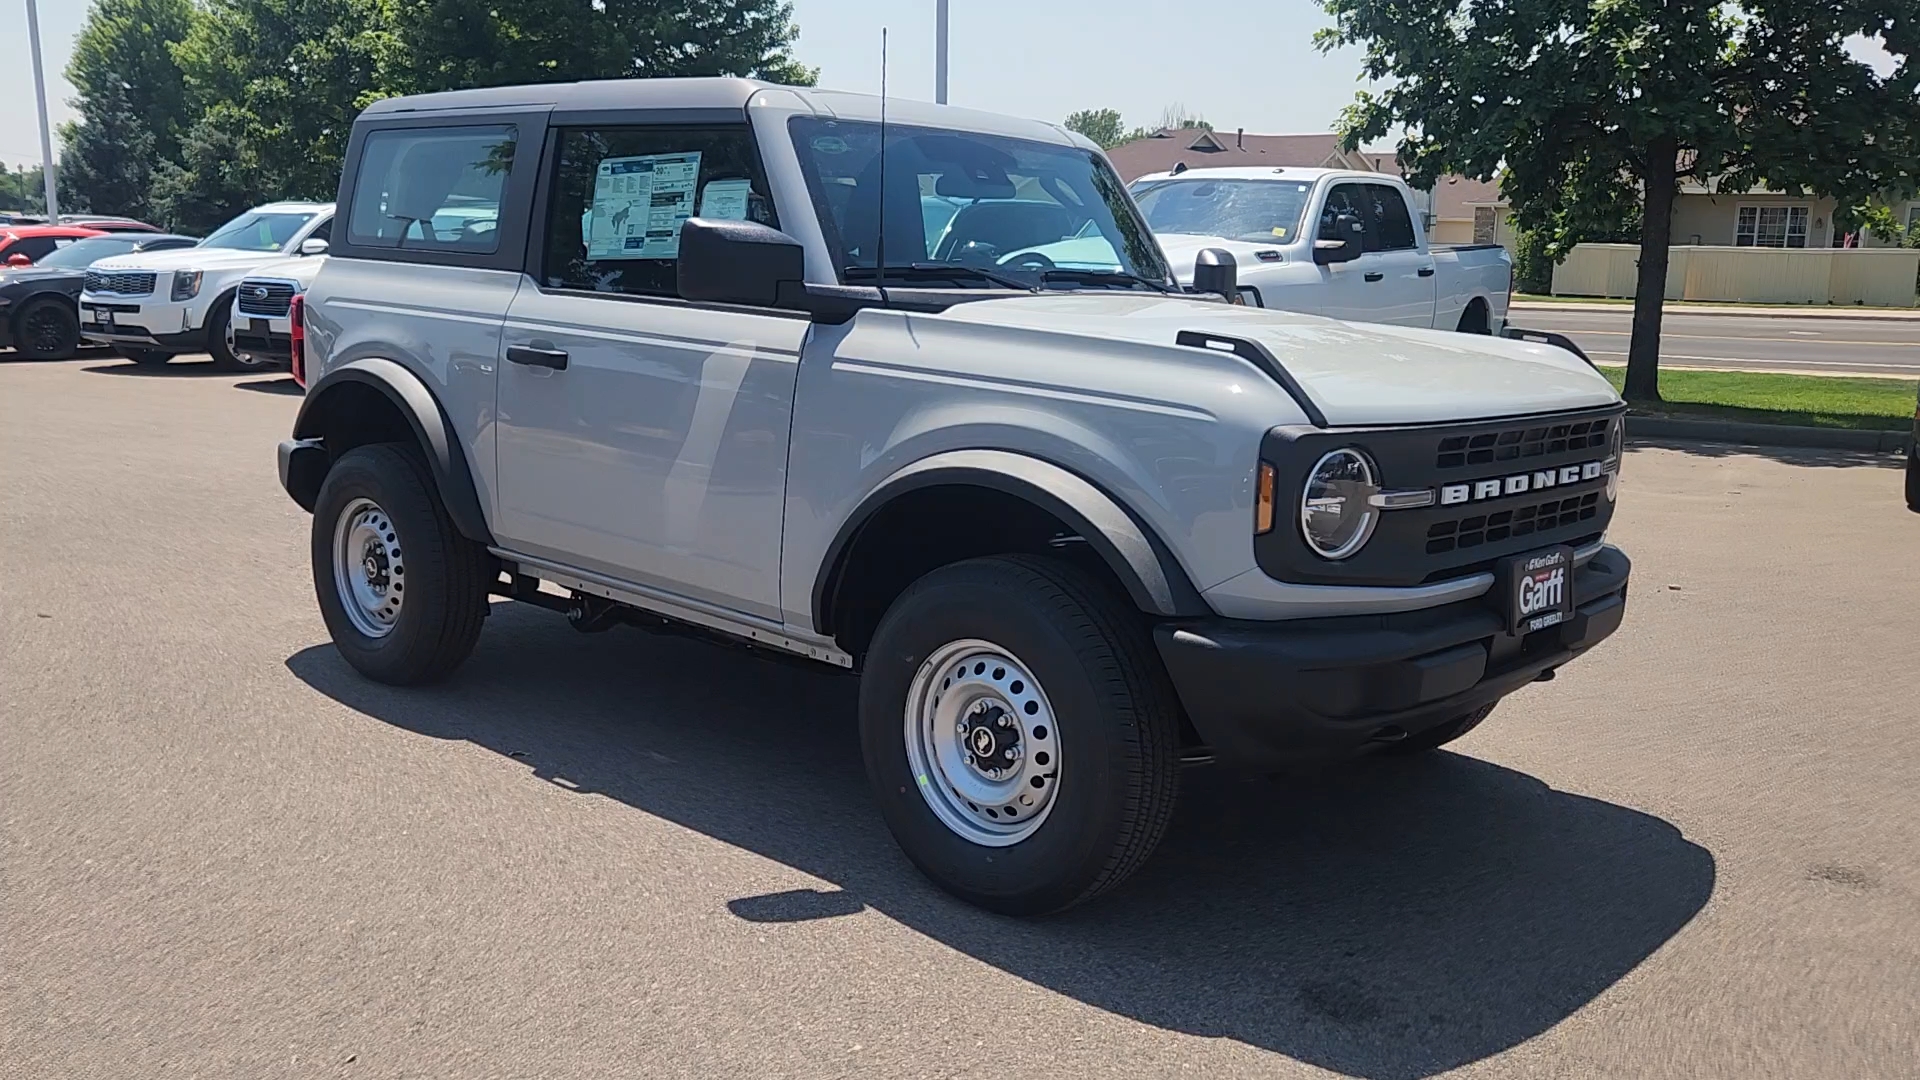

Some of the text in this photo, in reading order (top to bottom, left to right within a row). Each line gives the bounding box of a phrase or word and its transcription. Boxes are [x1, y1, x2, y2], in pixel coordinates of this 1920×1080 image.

[1441, 462, 1601, 505] BRONCO
[1519, 567, 1564, 614] Garff
[1530, 618, 1543, 631] FORD
